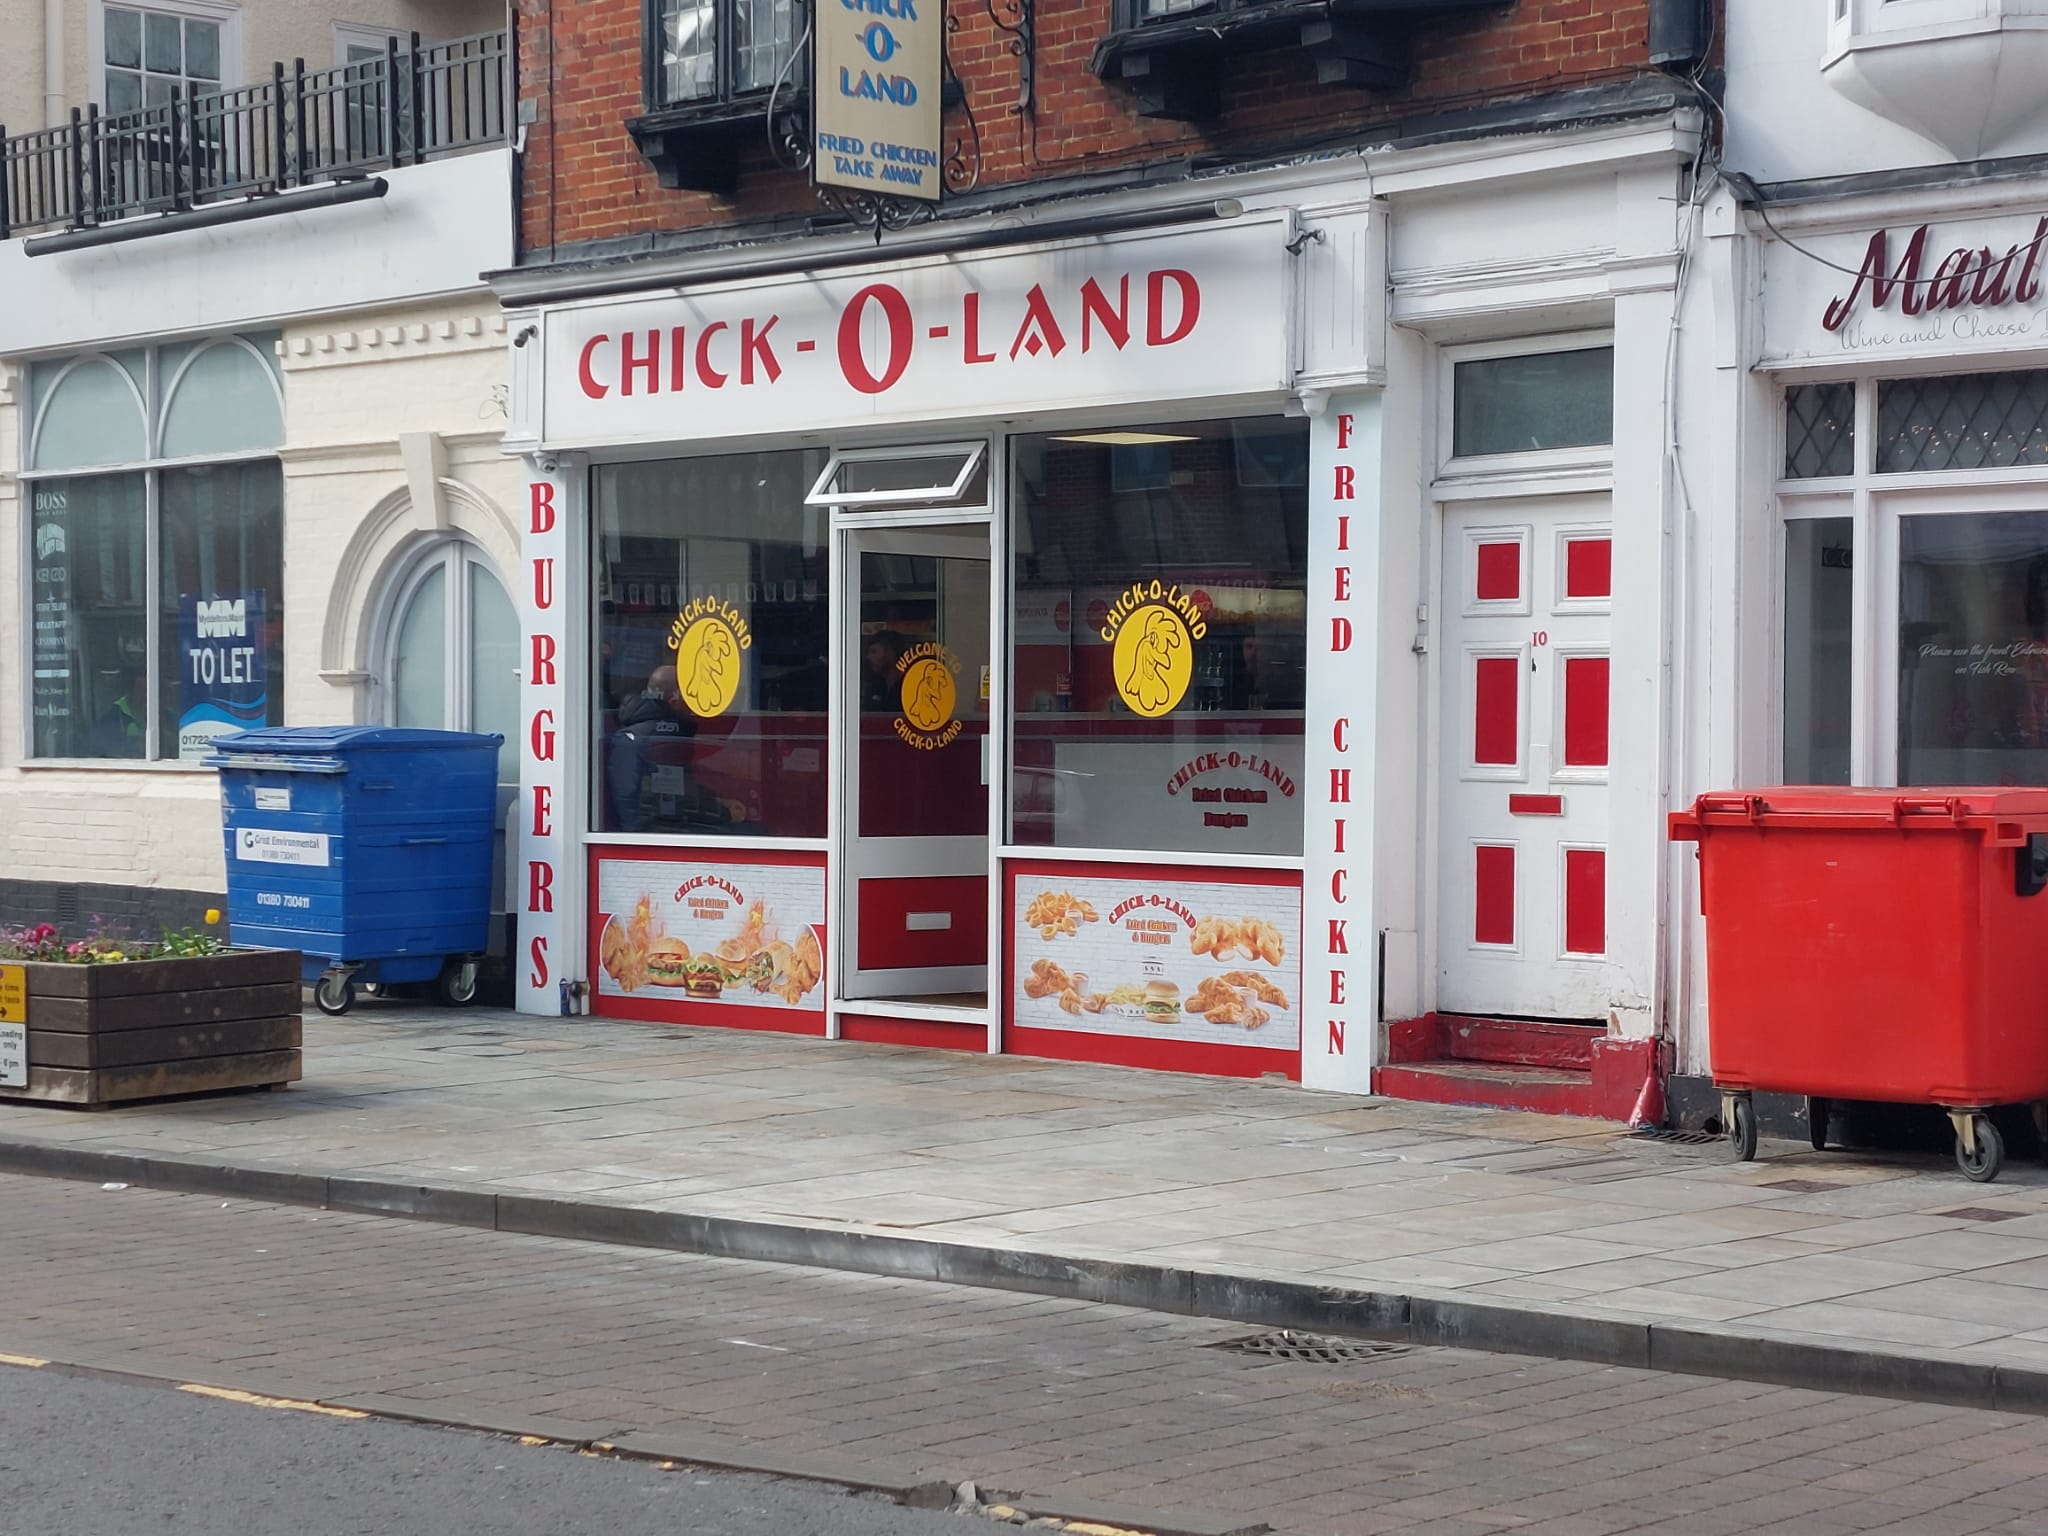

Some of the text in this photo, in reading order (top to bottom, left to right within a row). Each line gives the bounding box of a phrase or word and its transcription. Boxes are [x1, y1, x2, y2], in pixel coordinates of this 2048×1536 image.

[840, 66, 918, 106] LAND
[818, 132, 937, 168] FRIED CHICKEN
[834, 156, 923, 186] TAKE AWAY
[1841, 319, 1895, 350] Wine
[1900, 315, 1945, 344] and
[1952, 313, 2031, 339] Cheese
[36, 492, 66, 511] BOSS
[667, 594, 753, 650] CHICK-O-LAND
[1100, 579, 1209, 642] CHICK-O-LAND
[1532, 631, 1548, 647] 10
[189, 646, 255, 685] TO LET
[528, 482, 556, 989] BURGERS
[893, 718, 963, 751] CHICK-O-LAND
[1328, 415, 1355, 1056] FRIED CHICKEN
[1166, 751, 1296, 798] CHICK-O-LAND
[674, 875, 744, 906] CHICK-O-LAND
[1108, 894, 1196, 929] CHICK-O-LAND
[0, 1030, 23, 1041] oading
